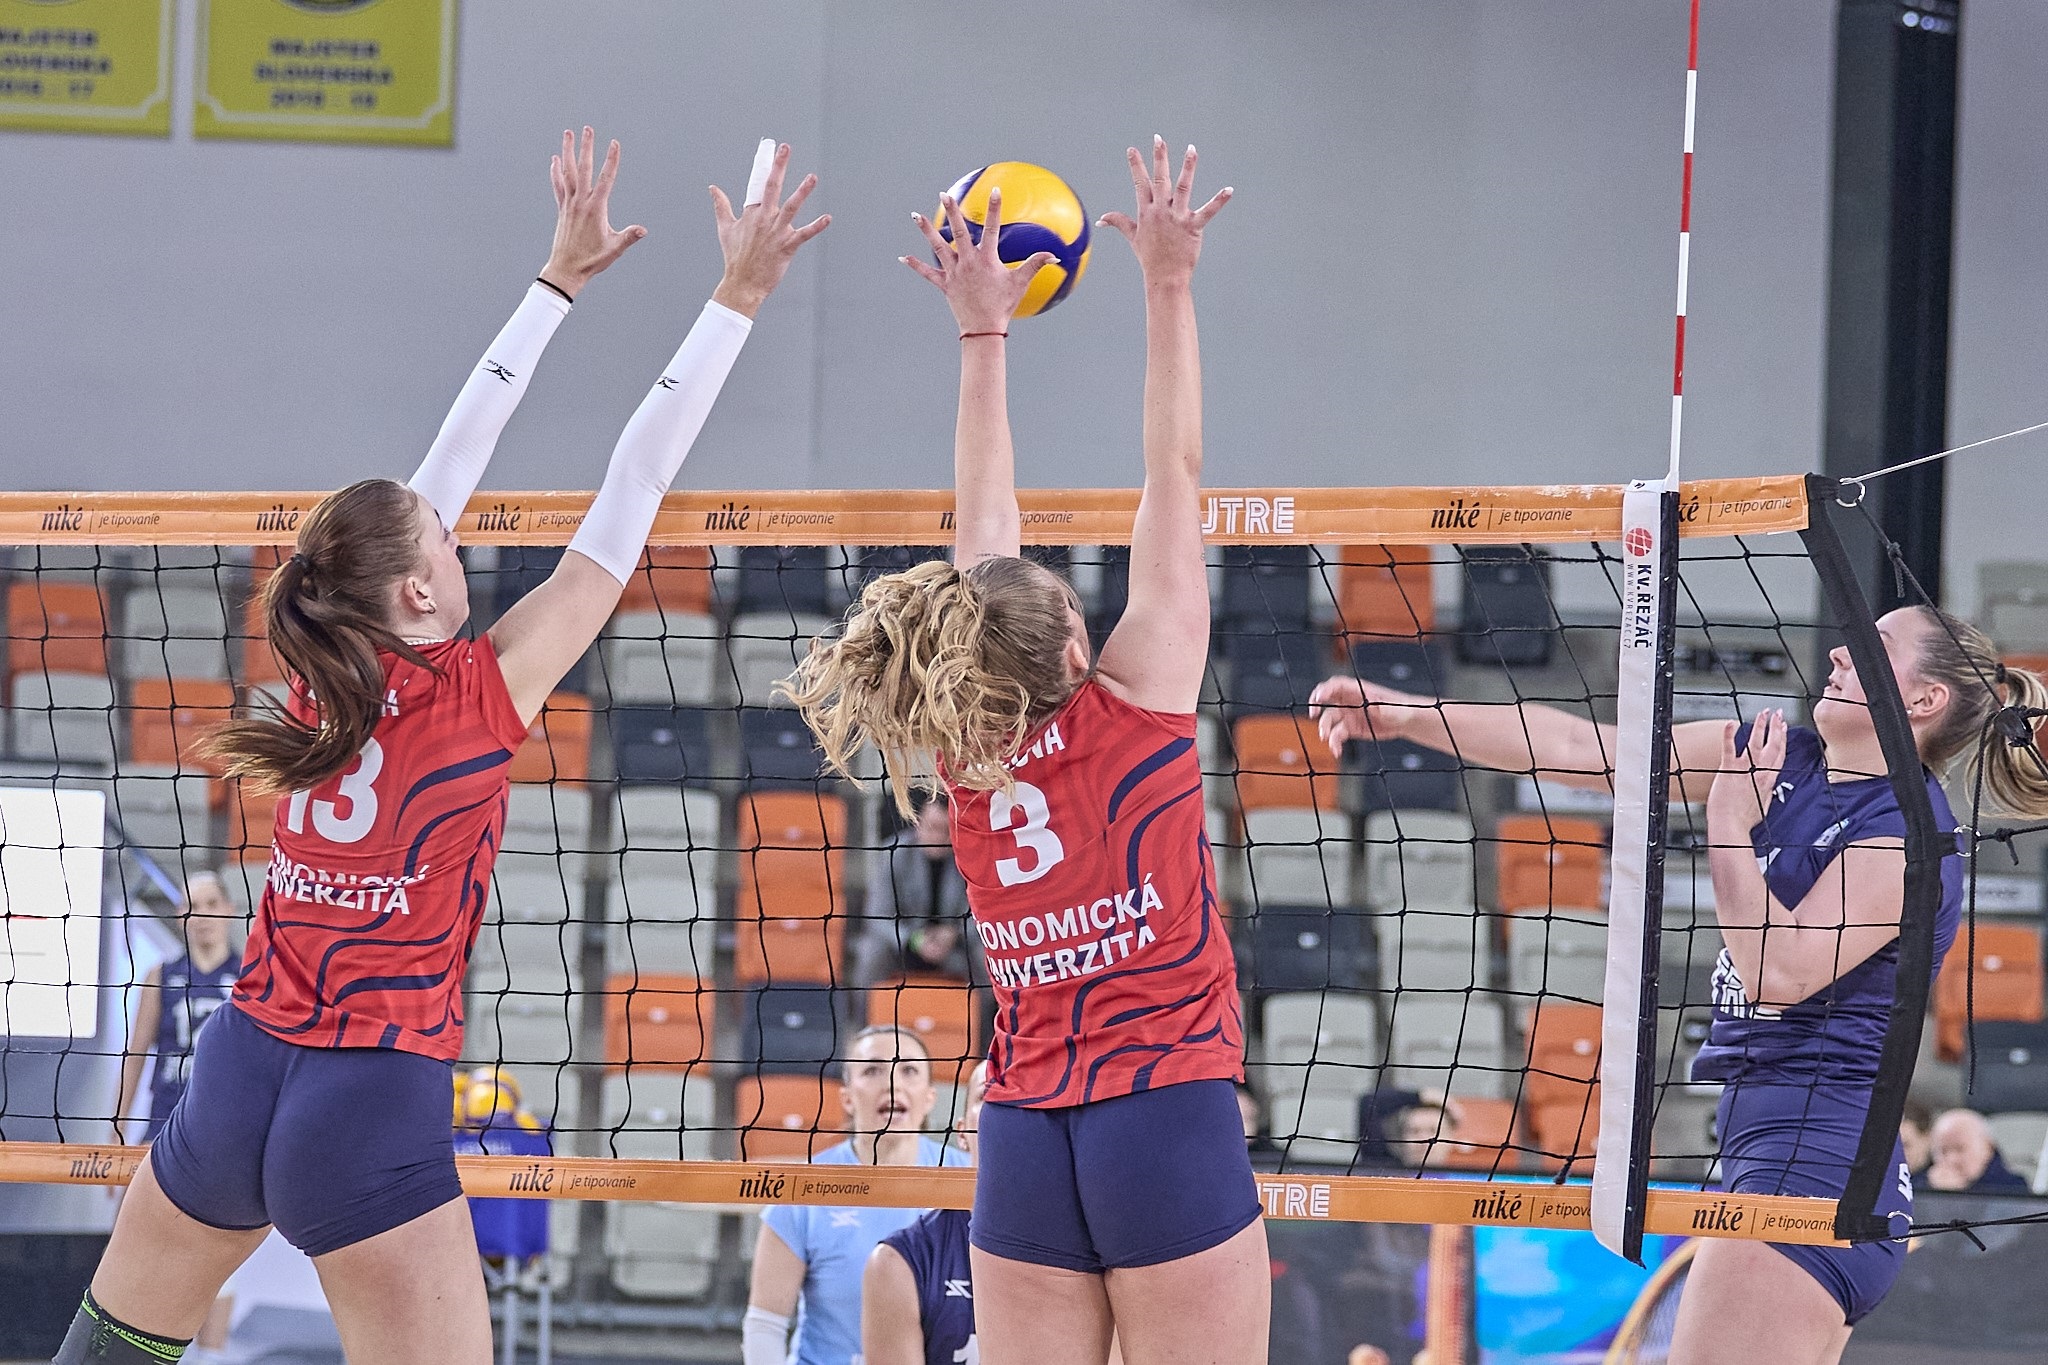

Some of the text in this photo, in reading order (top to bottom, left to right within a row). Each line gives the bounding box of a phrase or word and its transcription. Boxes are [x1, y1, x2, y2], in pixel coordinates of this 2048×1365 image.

[41, 504, 160, 531] niké je tipovanie
[256, 504, 298, 531] niké
[477, 503, 520, 531] niké
[537, 512, 549, 528] je
[705, 502, 835, 531] niké je tipovanie
[1431, 499, 1573, 529] niké je tipovanie
[1719, 500, 1732, 518] je
[1734, 496, 1792, 515] tipovanie
[990, 782, 1064, 887] 3
[69, 1152, 112, 1179] niké
[509, 1163, 636, 1192] niké je tipovanie
[739, 1170, 870, 1199] niké je tipovanie
[1257, 1182, 1330, 1218] TRE
[1472, 1190, 1522, 1222] niké
[1540, 1202, 1554, 1219] je
[1692, 1199, 1837, 1233] niké je tipovanie
